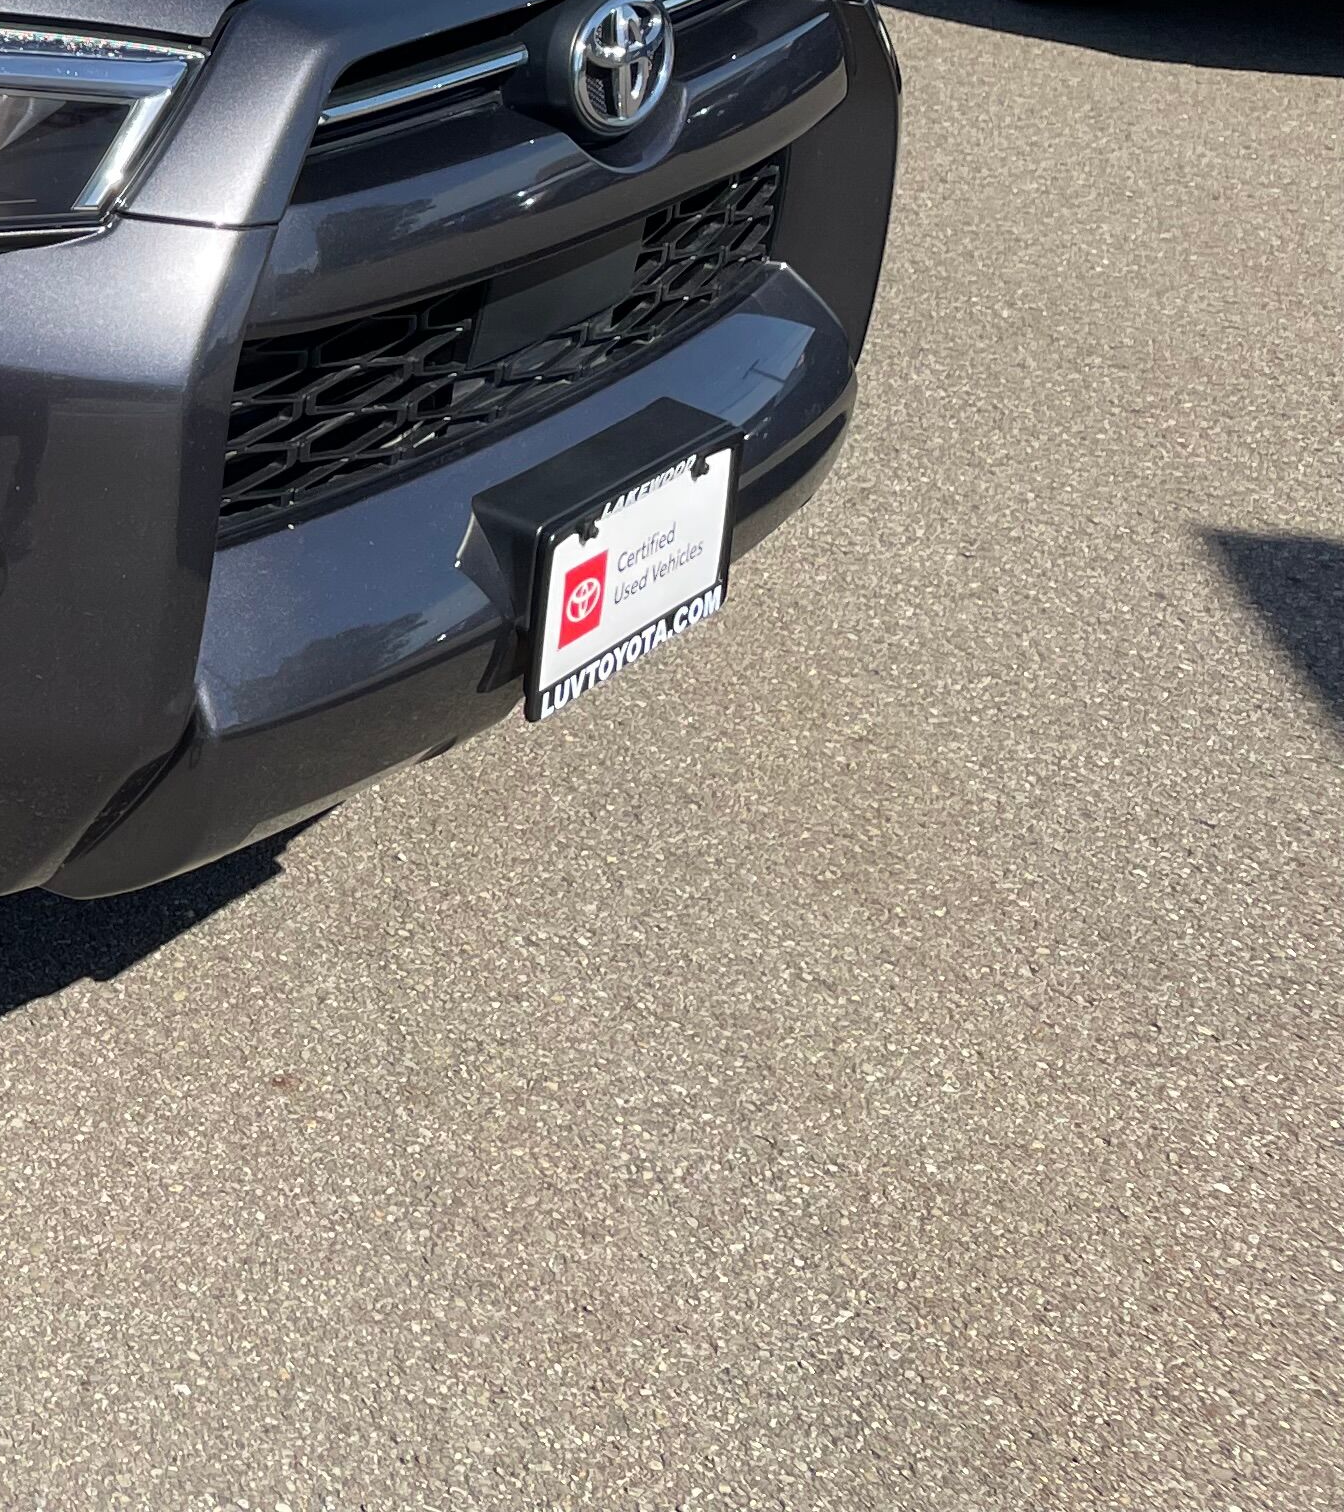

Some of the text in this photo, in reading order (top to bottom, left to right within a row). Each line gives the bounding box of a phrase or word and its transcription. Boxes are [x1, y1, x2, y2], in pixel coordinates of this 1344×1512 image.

[614, 540, 704, 605] Used Vehicles
[616, 521, 676, 573] Certified
[540, 585, 723, 721] LUVTOYOTA.COM
